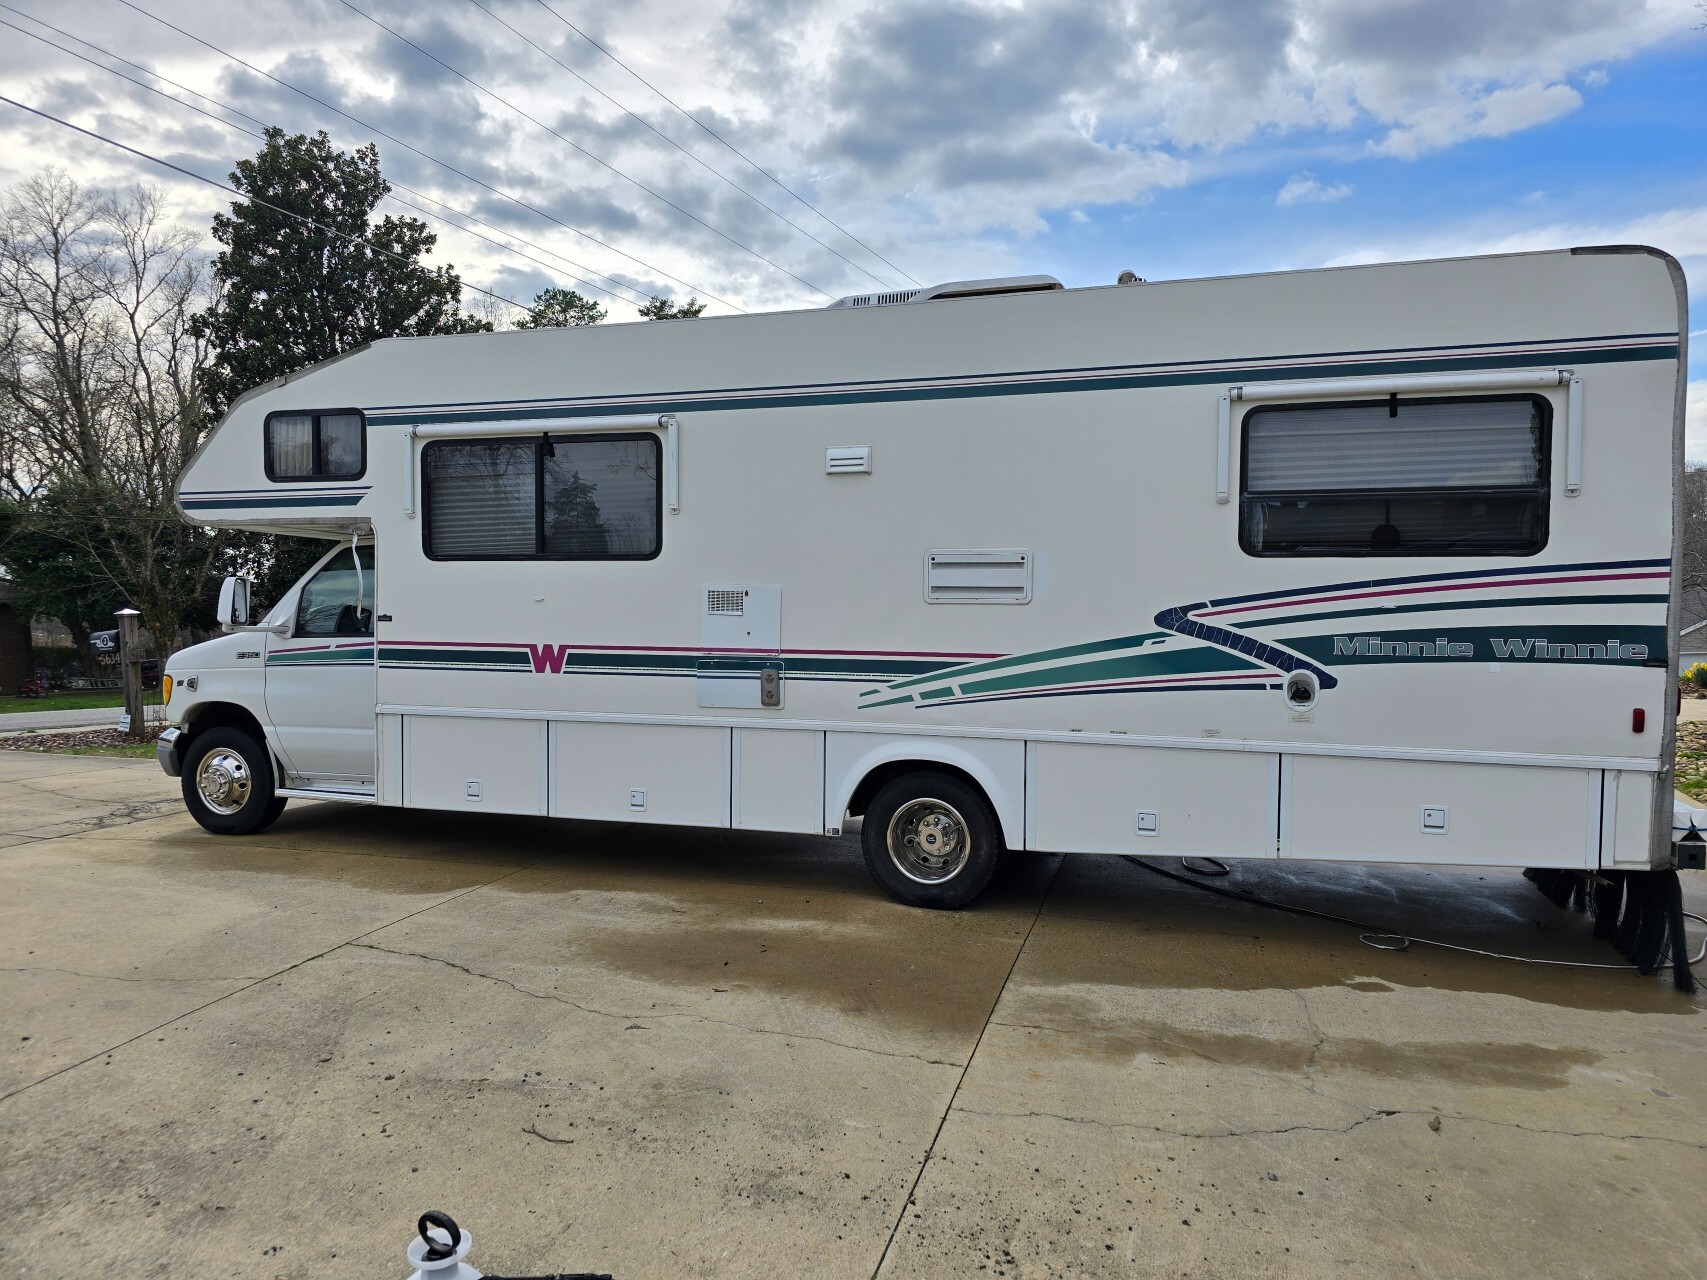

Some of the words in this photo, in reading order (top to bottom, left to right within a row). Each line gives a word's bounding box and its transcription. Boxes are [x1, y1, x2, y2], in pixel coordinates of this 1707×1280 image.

[1333, 637, 1474, 657] Minnie
[1489, 638, 1649, 660] Winnie
[100, 653, 121, 665] 5634
[236, 651, 261, 660] E350
